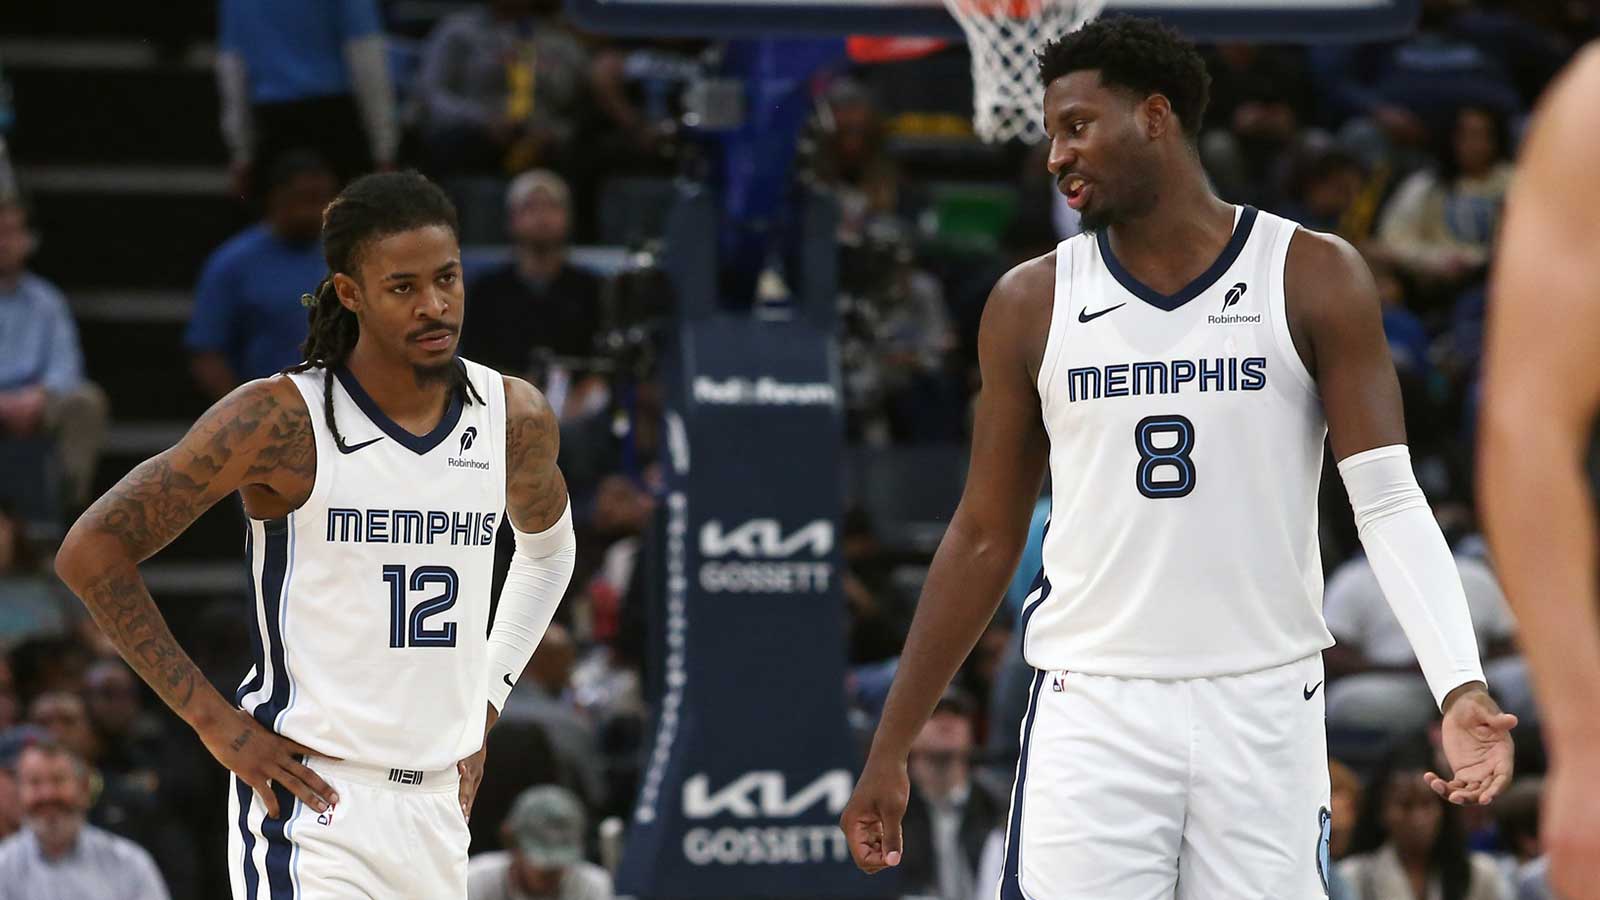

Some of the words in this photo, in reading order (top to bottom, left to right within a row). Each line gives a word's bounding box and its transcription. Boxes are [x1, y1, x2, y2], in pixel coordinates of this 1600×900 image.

[1207, 314, 1261, 325] Robinhood
[1067, 357, 1267, 402] MEMPHIS
[448, 457, 490, 470] Robinhood
[1135, 414, 1196, 499] 8
[326, 507, 496, 546] MEMPHIS
[382, 564, 459, 648] 12
